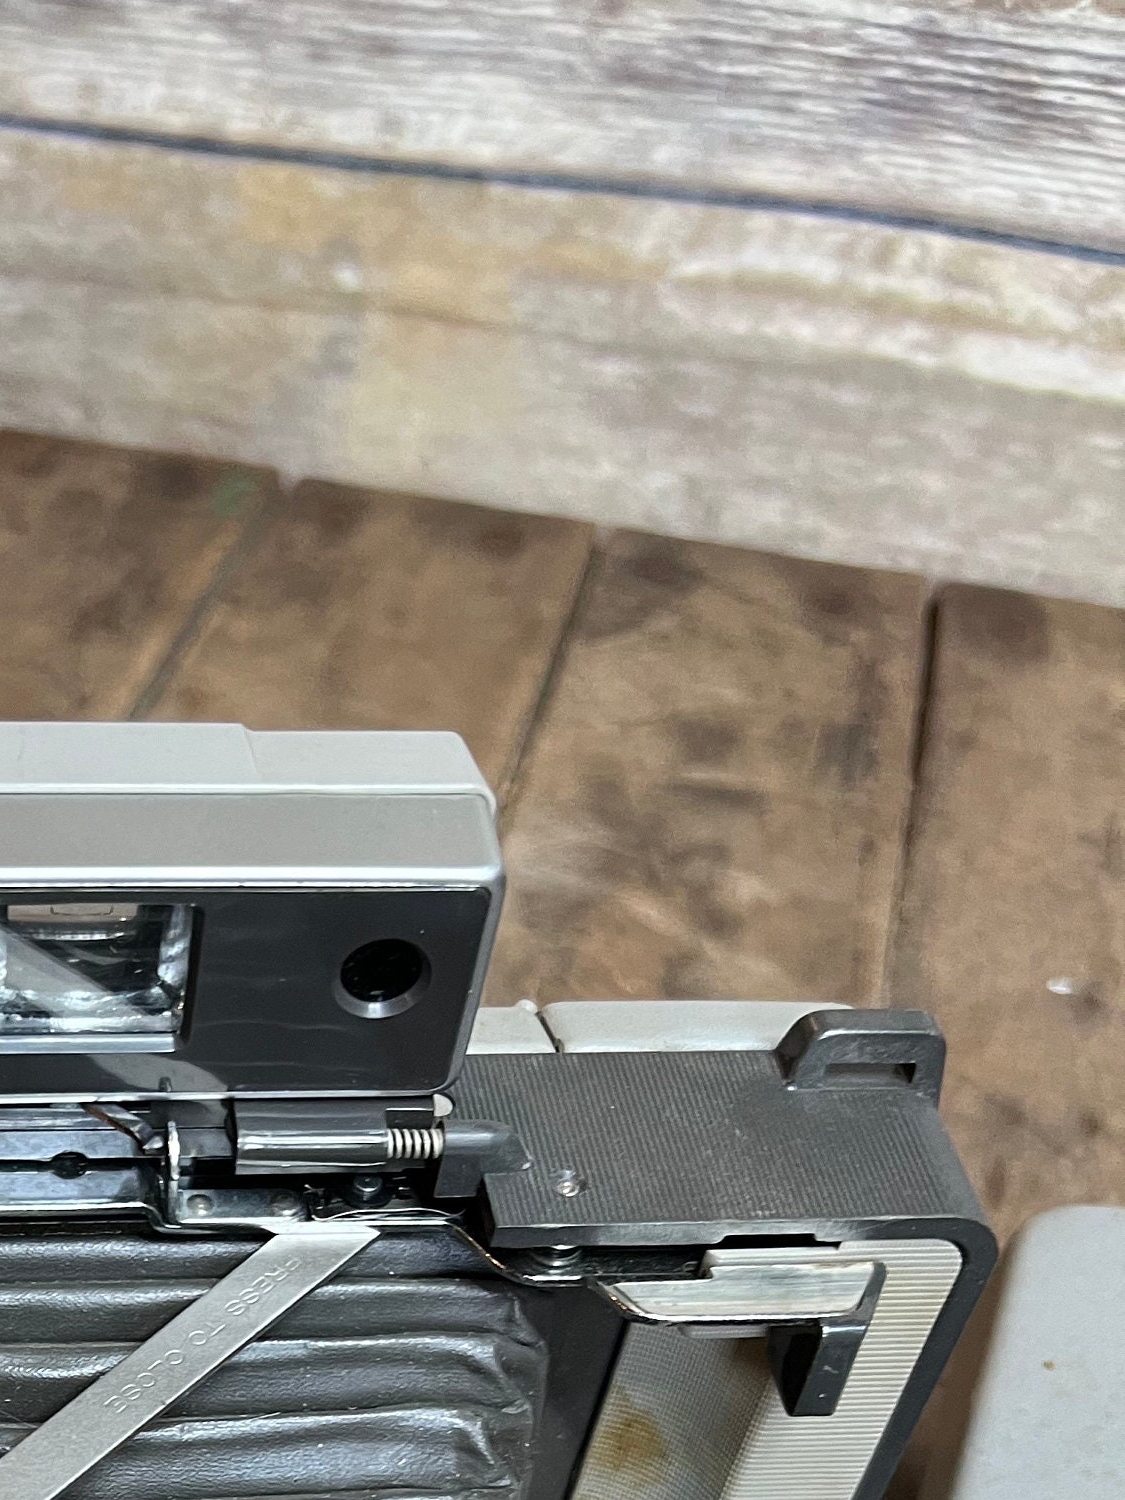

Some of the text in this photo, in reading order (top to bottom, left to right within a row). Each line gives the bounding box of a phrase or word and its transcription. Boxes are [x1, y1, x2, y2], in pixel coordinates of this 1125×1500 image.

[103, 1257, 304, 1414] PRESS TO CLOSE
